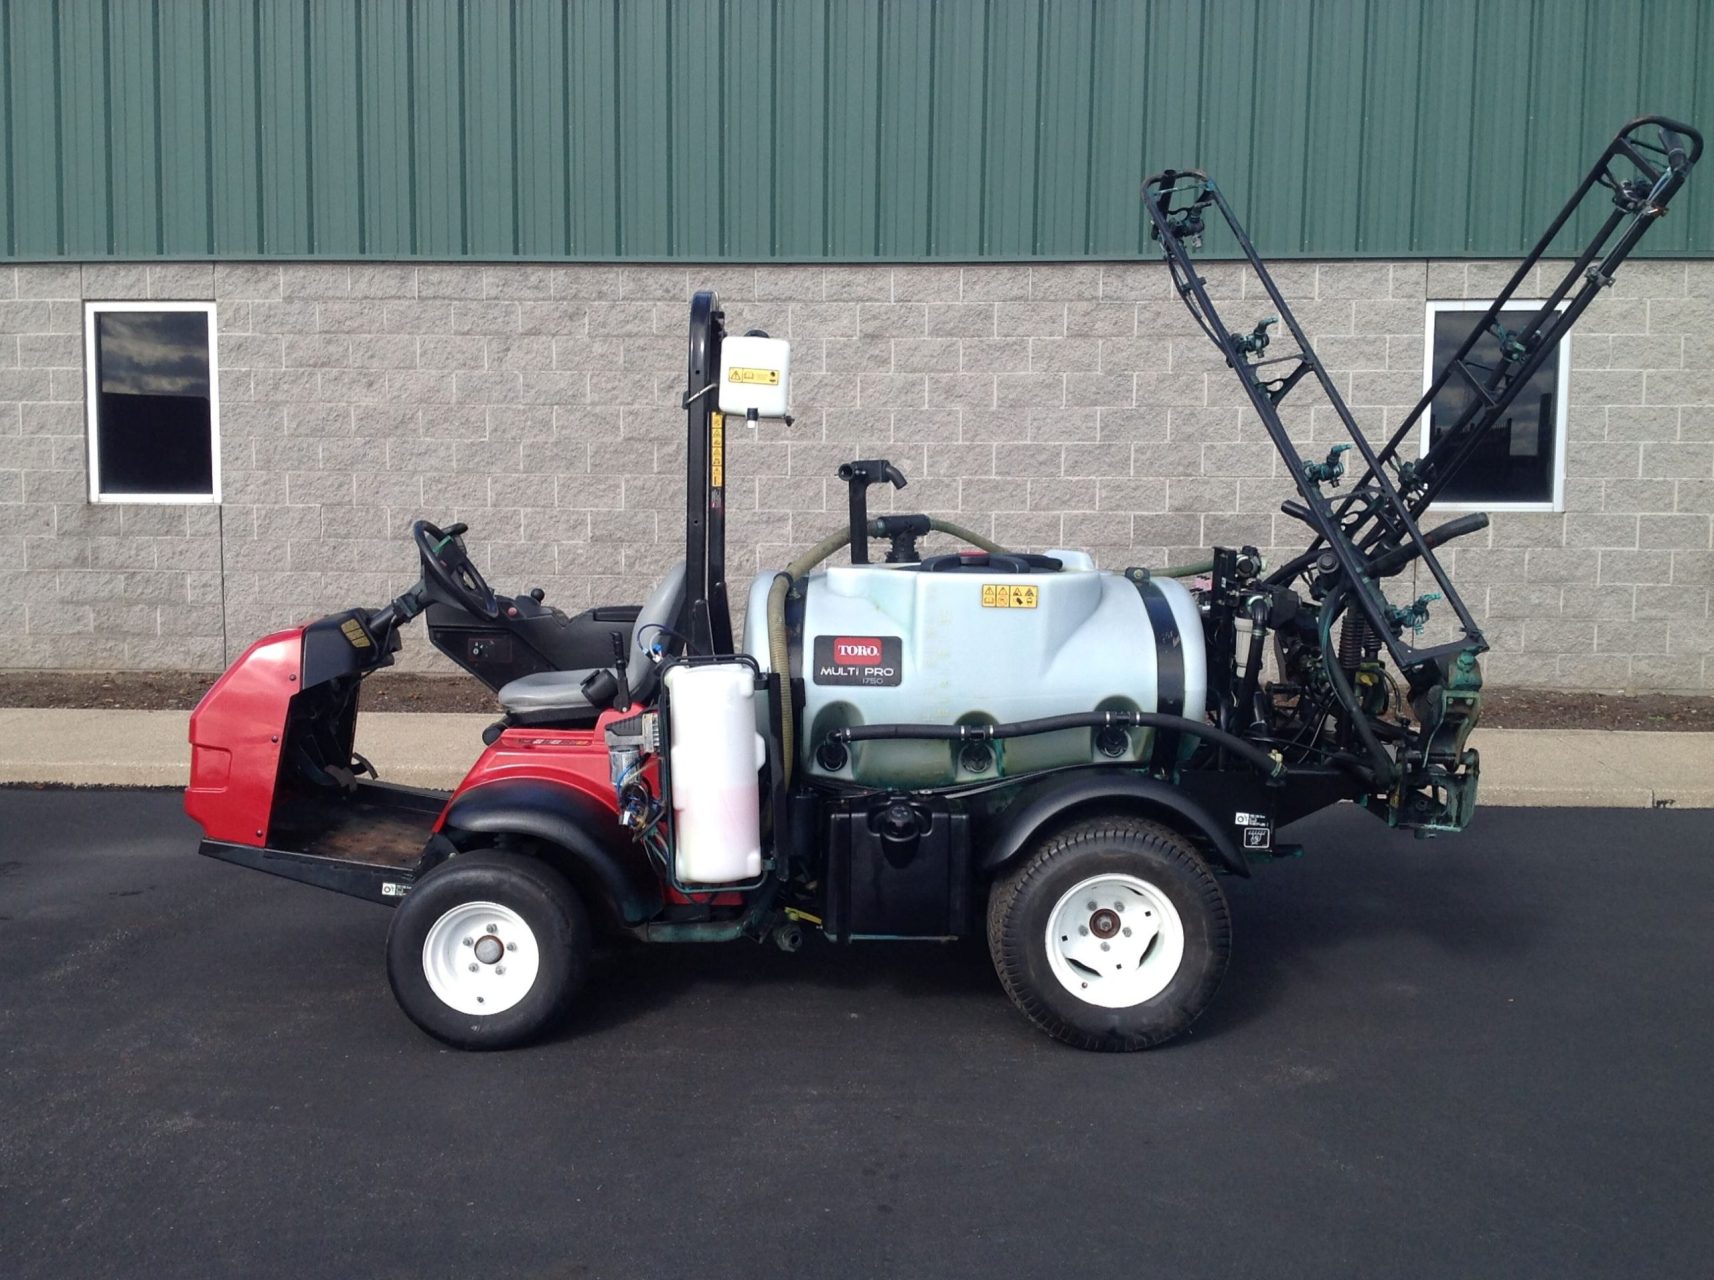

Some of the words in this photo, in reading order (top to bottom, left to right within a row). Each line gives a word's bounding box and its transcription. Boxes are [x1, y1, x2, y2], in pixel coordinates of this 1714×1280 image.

[838, 645, 878, 656] TORO
[820, 667, 859, 676] MULTI
[864, 667, 894, 677] PRO
[862, 677, 884, 685] 1750
